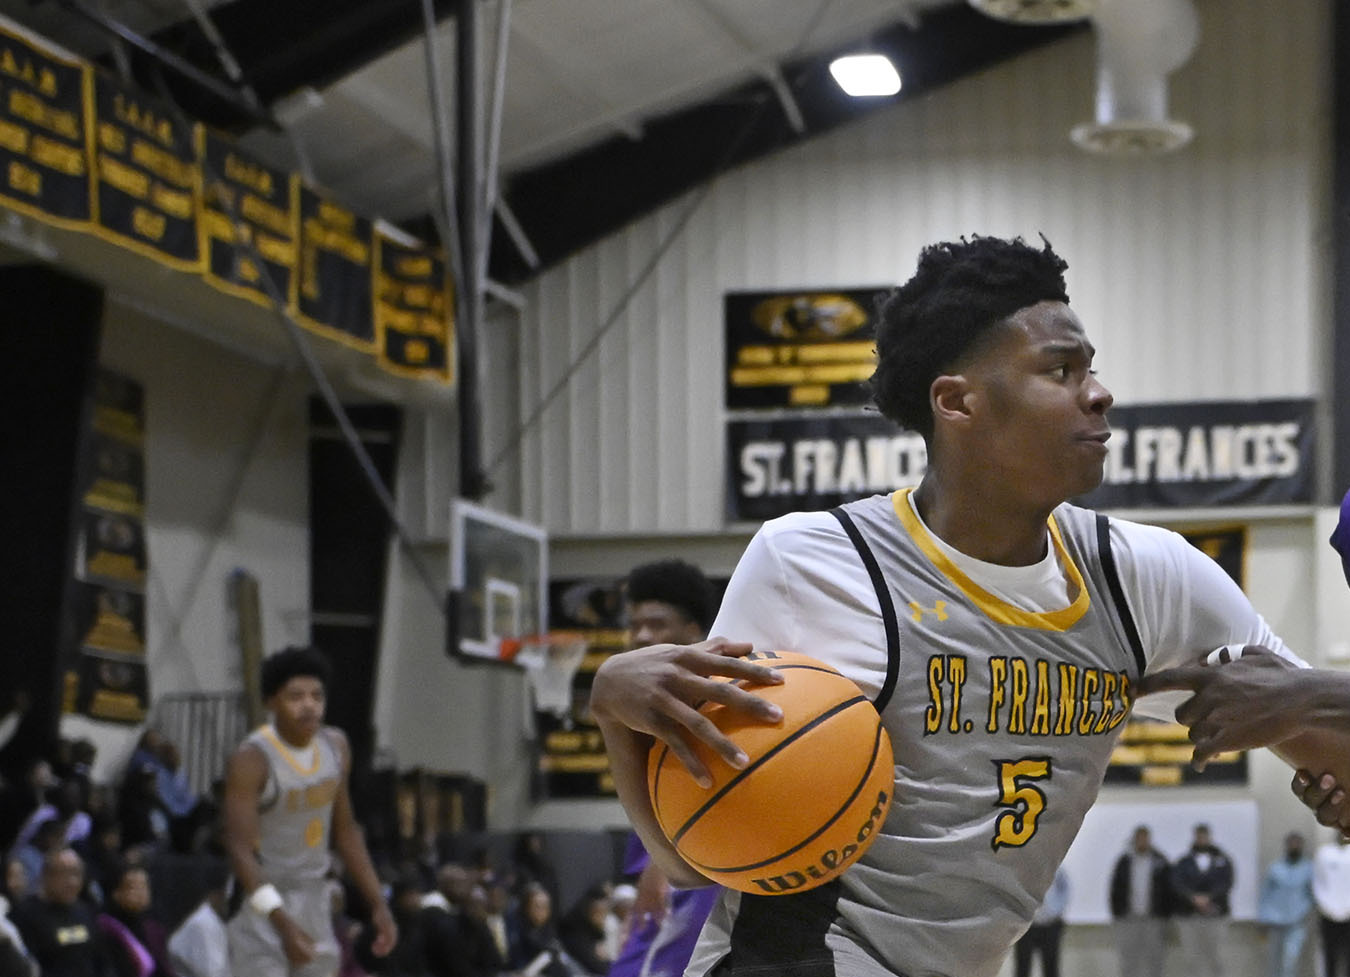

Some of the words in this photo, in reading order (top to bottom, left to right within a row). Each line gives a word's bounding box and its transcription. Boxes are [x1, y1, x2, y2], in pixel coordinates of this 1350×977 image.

[924, 654, 973, 737] ST.
[986, 655, 1132, 737] FRANCES
[991, 757, 1052, 853] 5
